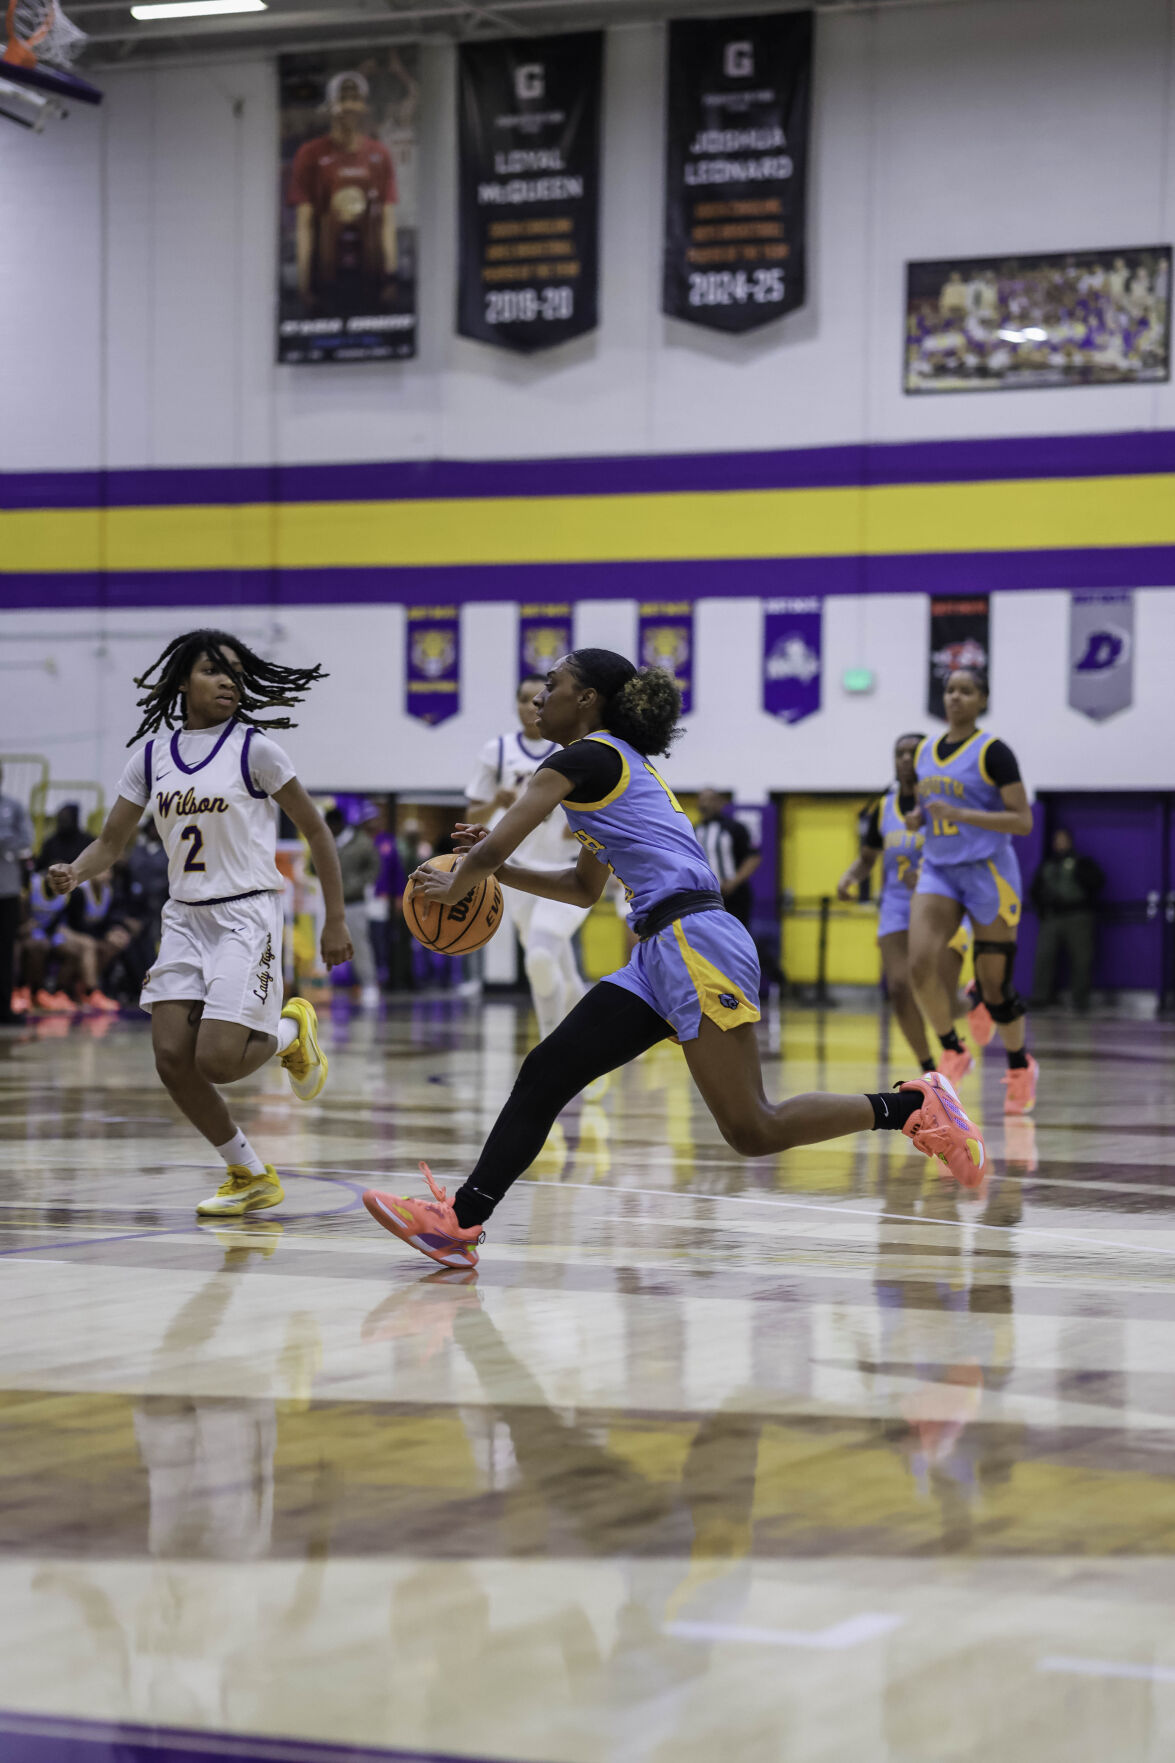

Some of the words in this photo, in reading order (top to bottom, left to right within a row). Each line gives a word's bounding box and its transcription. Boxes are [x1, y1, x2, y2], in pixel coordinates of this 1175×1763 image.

[725, 40, 754, 78] G
[515, 63, 545, 100] G
[690, 129, 786, 155] JOSHUA
[495, 151, 565, 174] LOYAL
[684, 156, 793, 186] LEONARD
[478, 176, 583, 204] McQUEEN
[689, 269, 784, 306] 2024-25
[156, 787, 229, 819] Wilson
[181, 824, 206, 872] 2
[259, 932, 276, 970] Tigers
[253, 971, 274, 1006] Lady
